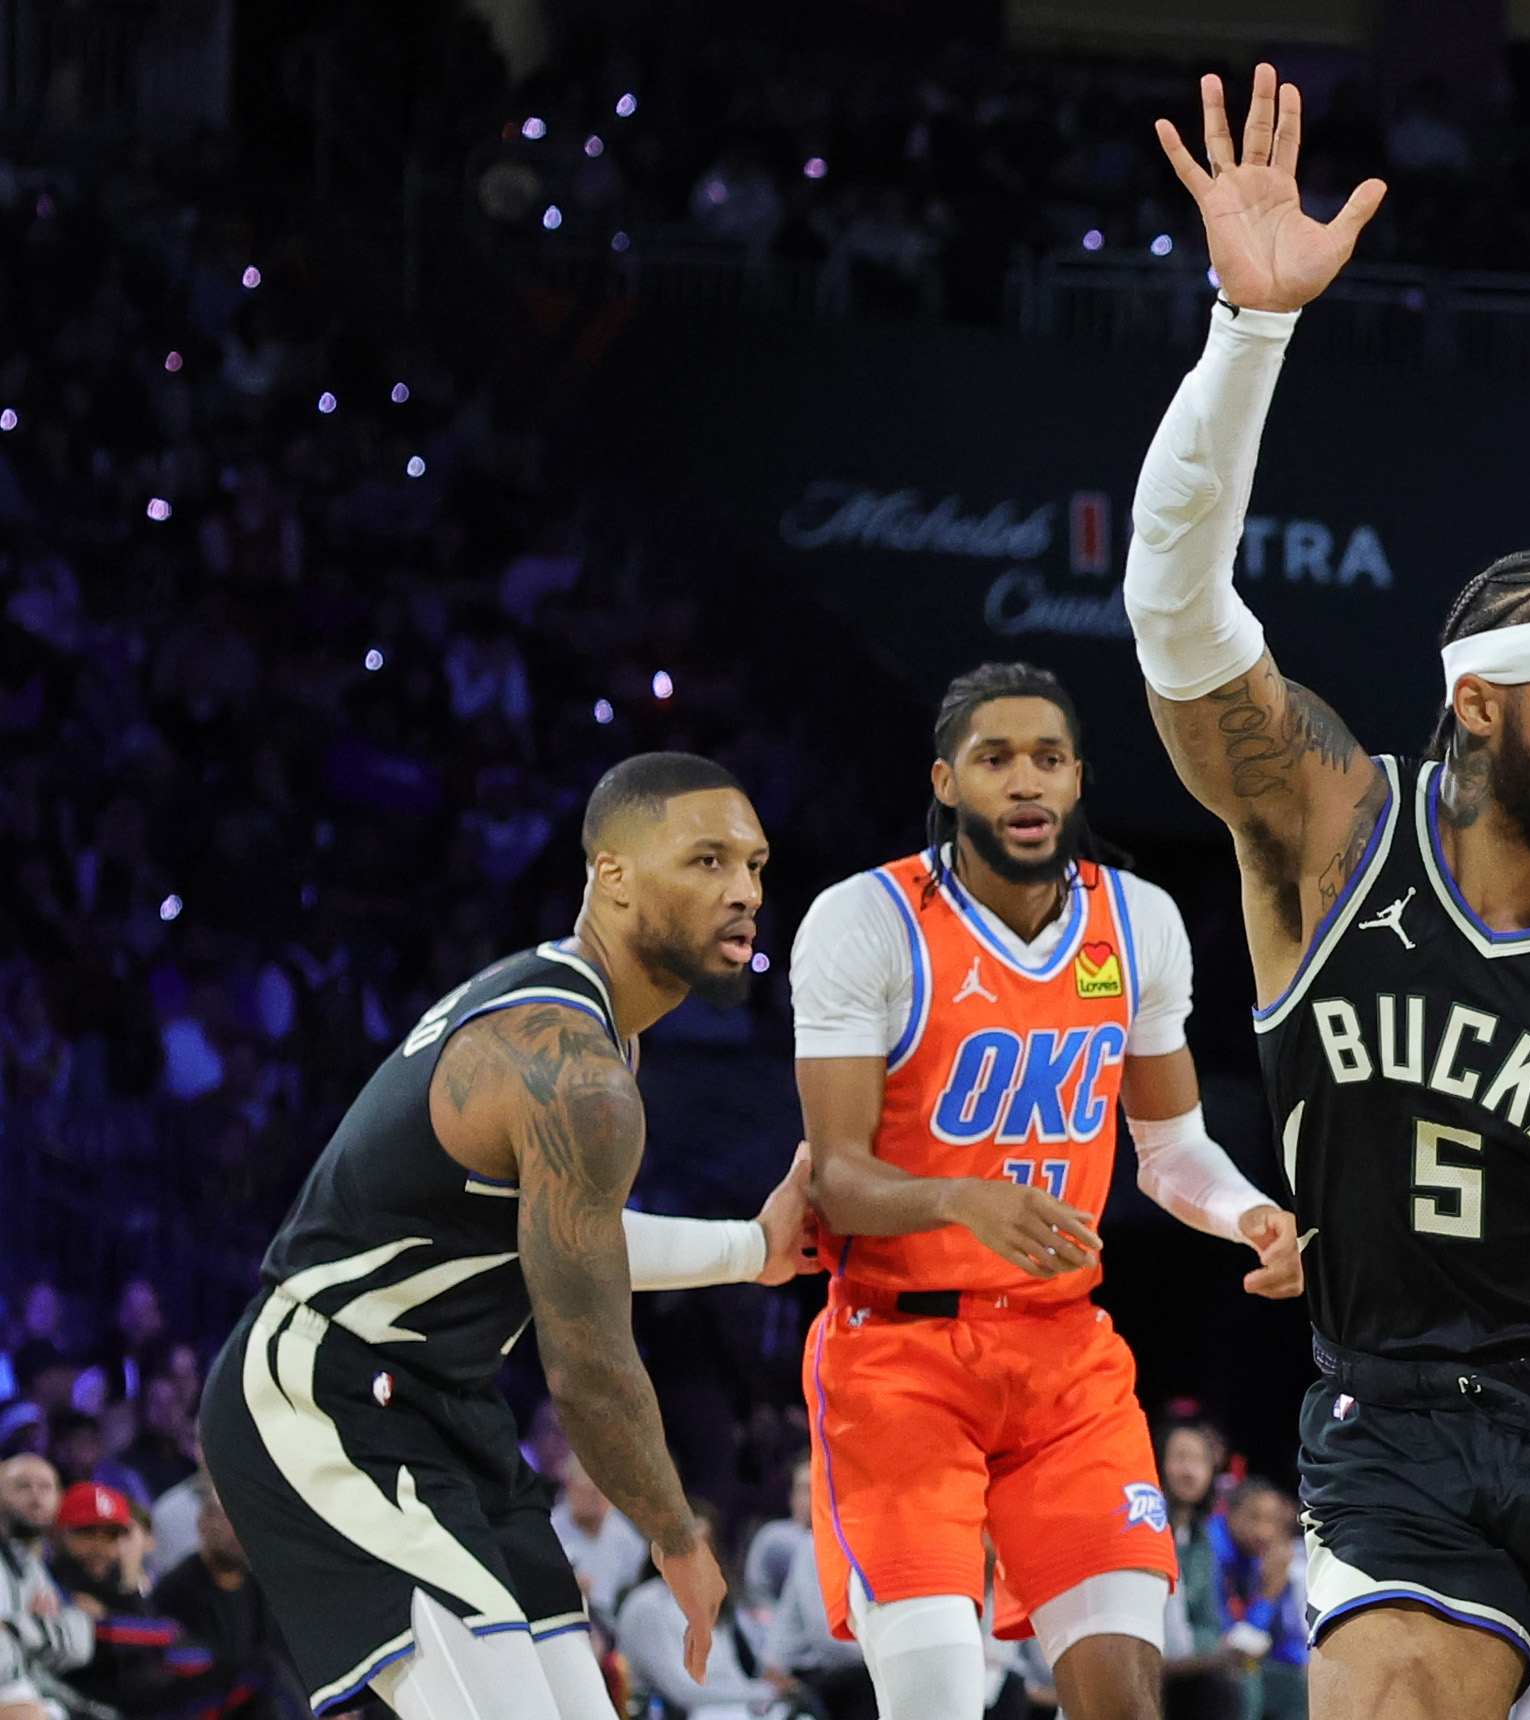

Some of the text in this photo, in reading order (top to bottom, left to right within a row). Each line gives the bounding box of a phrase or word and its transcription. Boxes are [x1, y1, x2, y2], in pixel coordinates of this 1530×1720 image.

[1243, 516, 1394, 589] TRA
[930, 1021, 1128, 1146] OKC
[1411, 1116, 1485, 1242] 5
